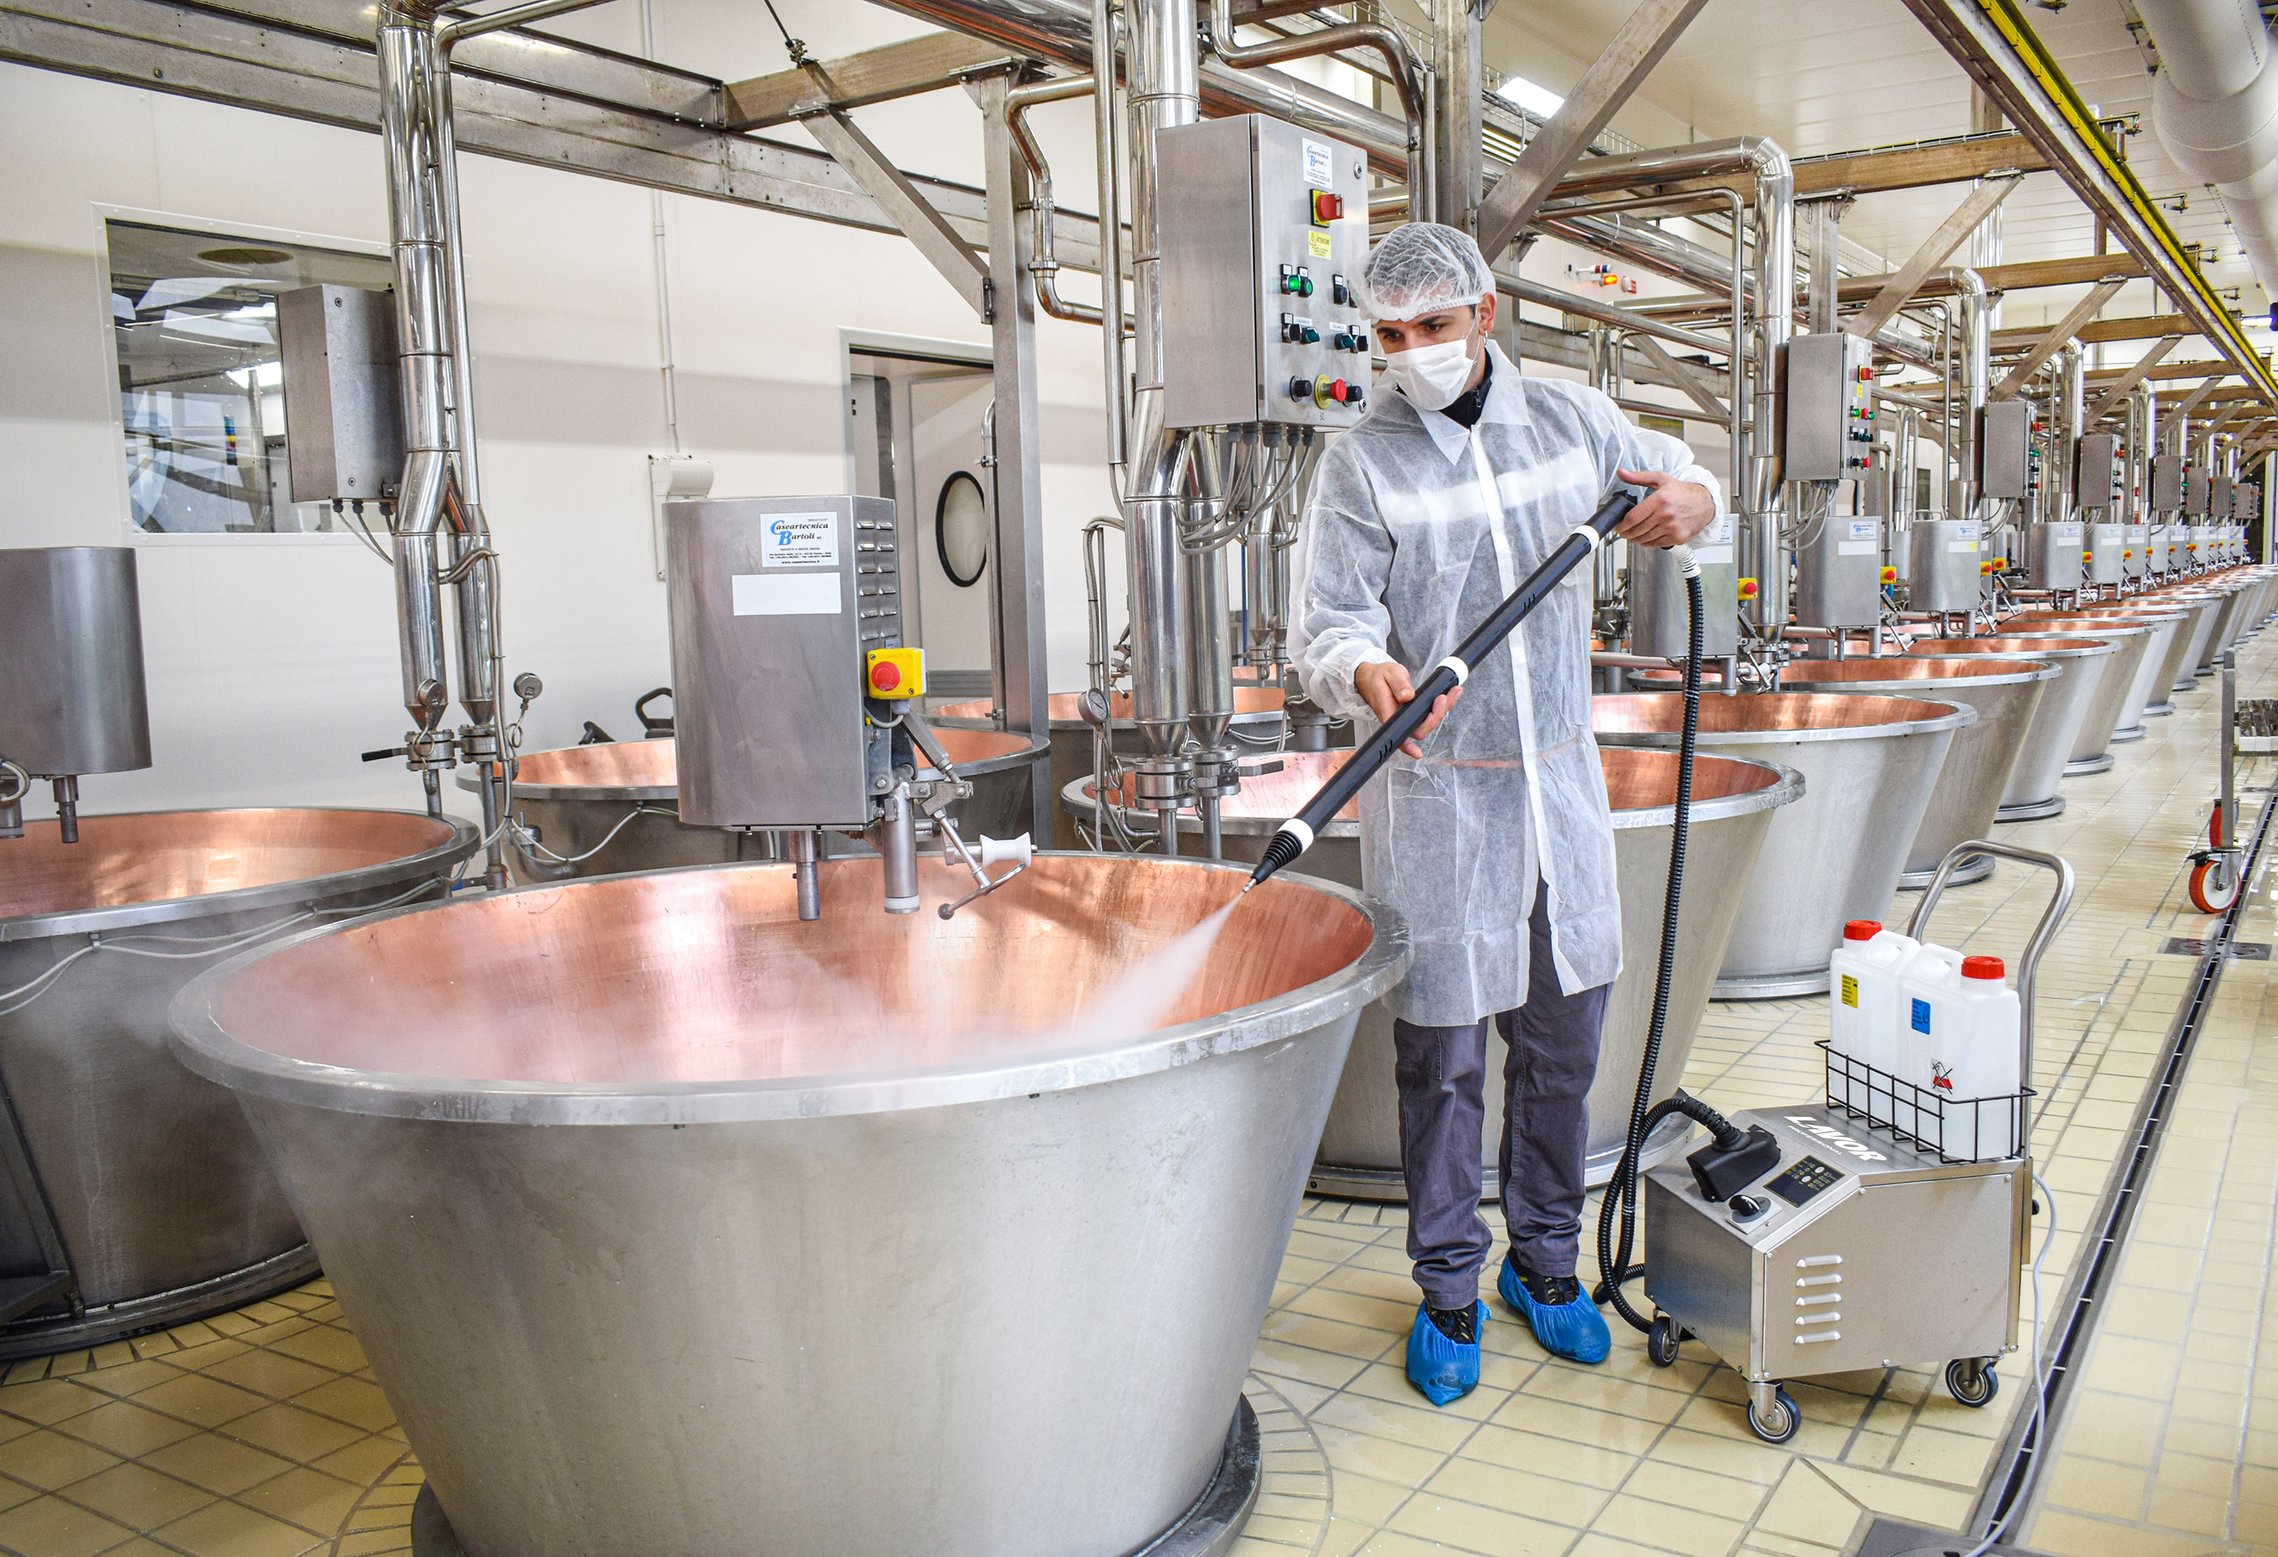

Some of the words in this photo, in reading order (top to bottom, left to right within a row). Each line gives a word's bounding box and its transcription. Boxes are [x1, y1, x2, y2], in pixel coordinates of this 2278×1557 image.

[770, 519, 829, 535] Caseartecnica
[778, 530, 815, 546] Bartoli
[1784, 1116, 1888, 1161] LAVOR
